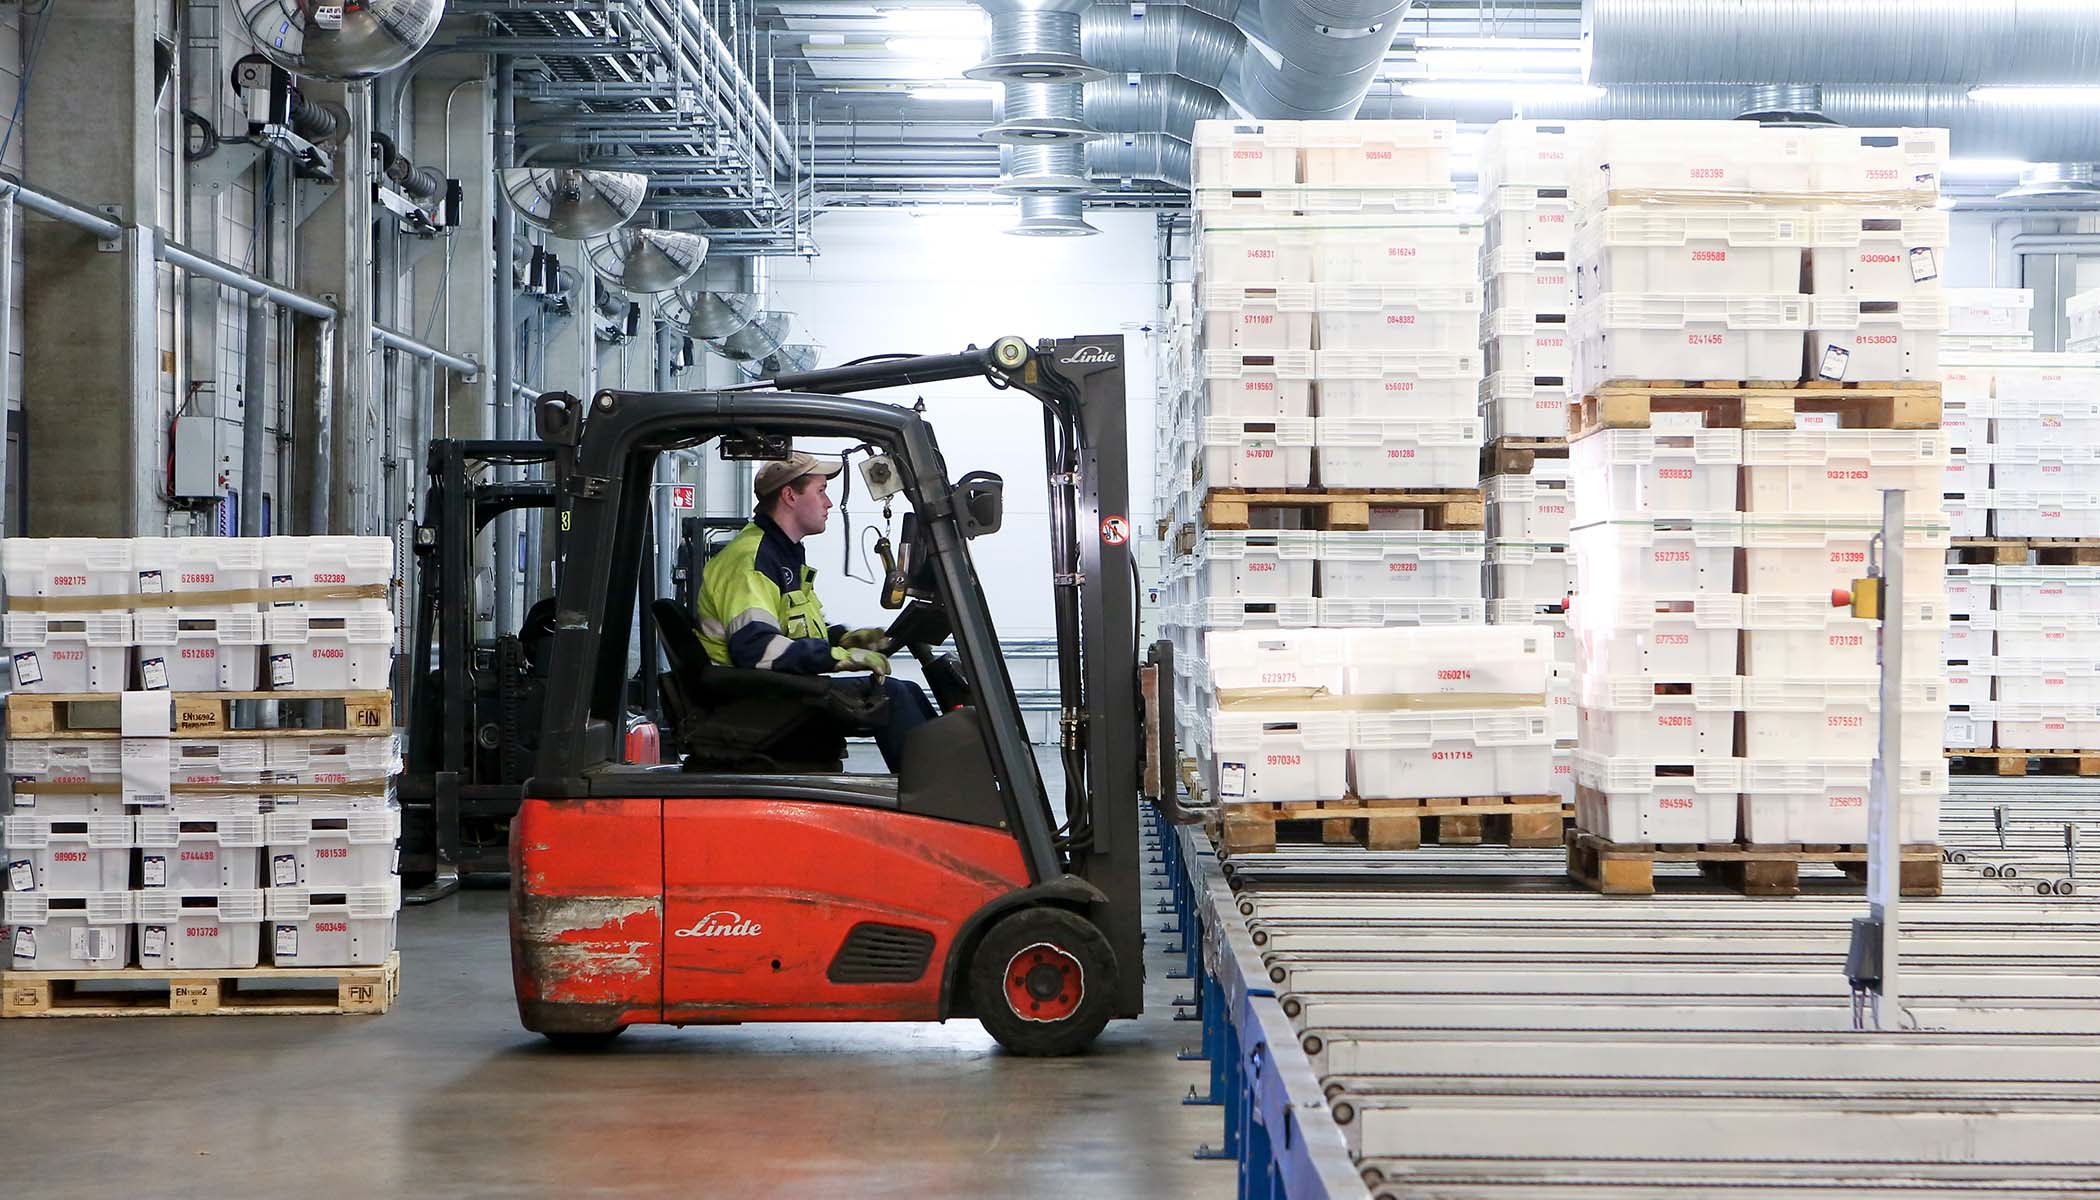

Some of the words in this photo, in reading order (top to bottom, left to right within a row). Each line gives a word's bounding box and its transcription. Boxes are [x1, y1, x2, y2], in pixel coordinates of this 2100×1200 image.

[1860, 255, 1901, 264] 9309041
[1688, 333, 1723, 345] 8241456
[1856, 335, 1898, 345] 8153803
[1060, 345, 1116, 364] Linde
[1827, 470, 1869, 480] 9321263
[54, 576, 86, 586] 8992175
[181, 573, 214, 584] 6268993
[314, 573, 346, 584] 9532389
[181, 649, 215, 659] 6512669
[1437, 669, 1471, 681] 9260214
[358, 709, 379, 725] FIN
[1828, 715, 1862, 727] 5575521
[1267, 754, 1301, 766] 9970343
[1431, 751, 1473, 761] 9311715
[54, 851, 87, 862] 9890512
[315, 848, 347, 859] 7881538
[674, 910, 762, 936] Linde
[186, 927, 218, 937] 9013728
[350, 986, 371, 1000] FIN
